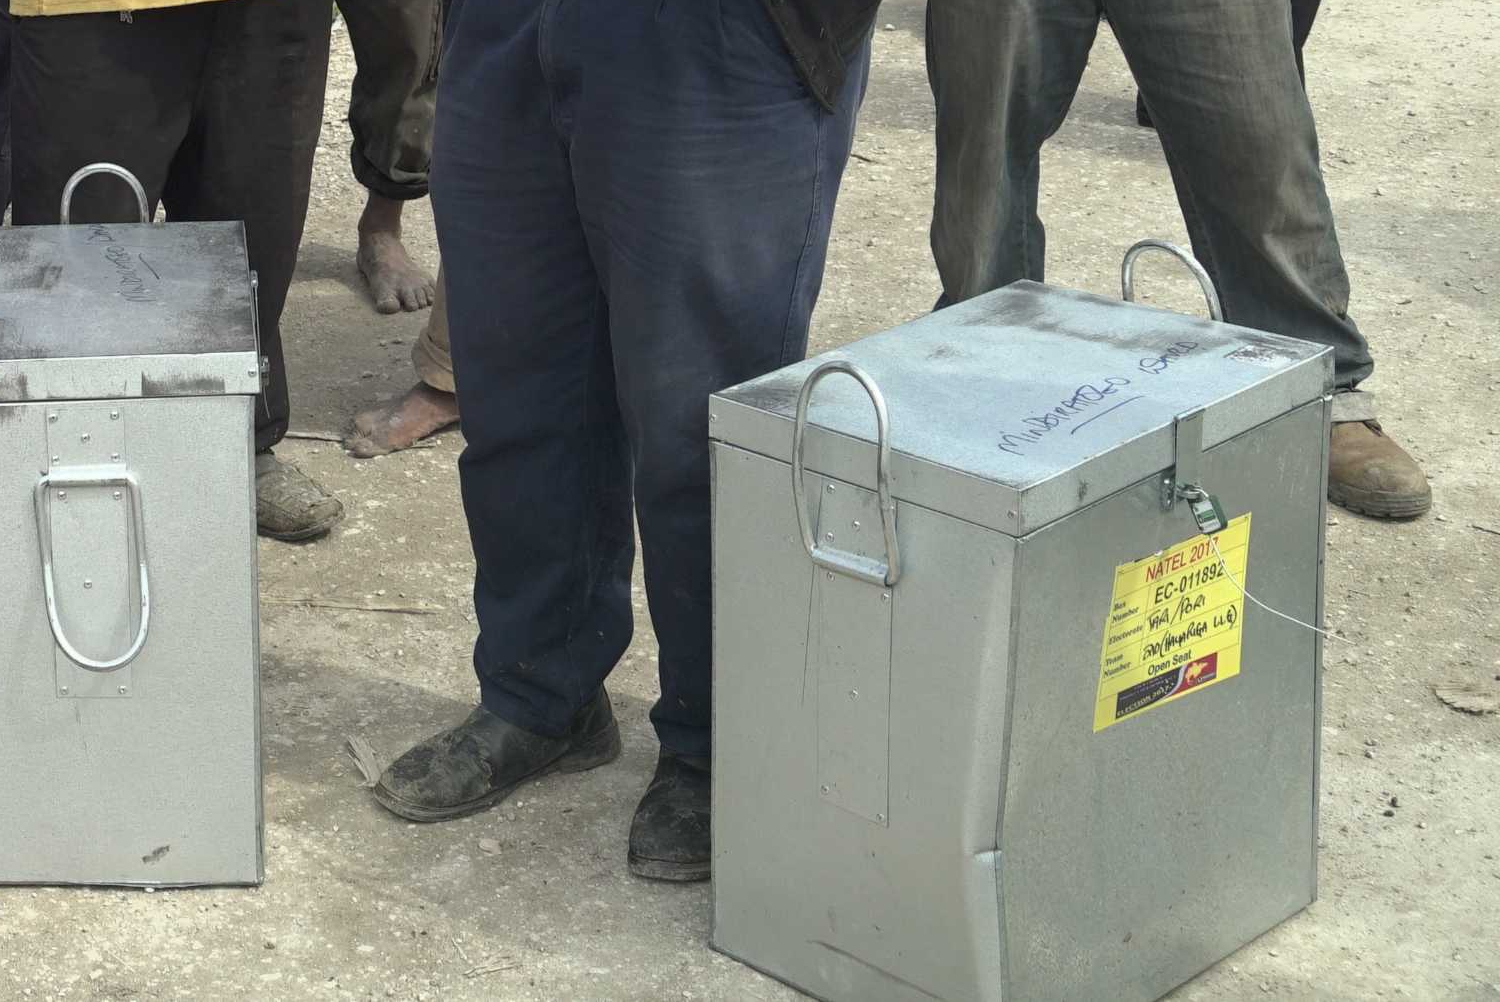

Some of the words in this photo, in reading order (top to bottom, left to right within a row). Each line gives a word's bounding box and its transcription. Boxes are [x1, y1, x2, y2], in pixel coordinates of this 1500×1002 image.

[1145, 551, 1187, 582] NATEL
[1189, 537, 1219, 563] 2017
[1155, 559, 1225, 604] EC-011892
[1112, 607, 1140, 623] Number
[1104, 662, 1131, 677] Number
[1147, 662, 1171, 676] Open
[1172, 650, 1192, 665] Seat
[1116, 695, 1152, 717] ELECTION
